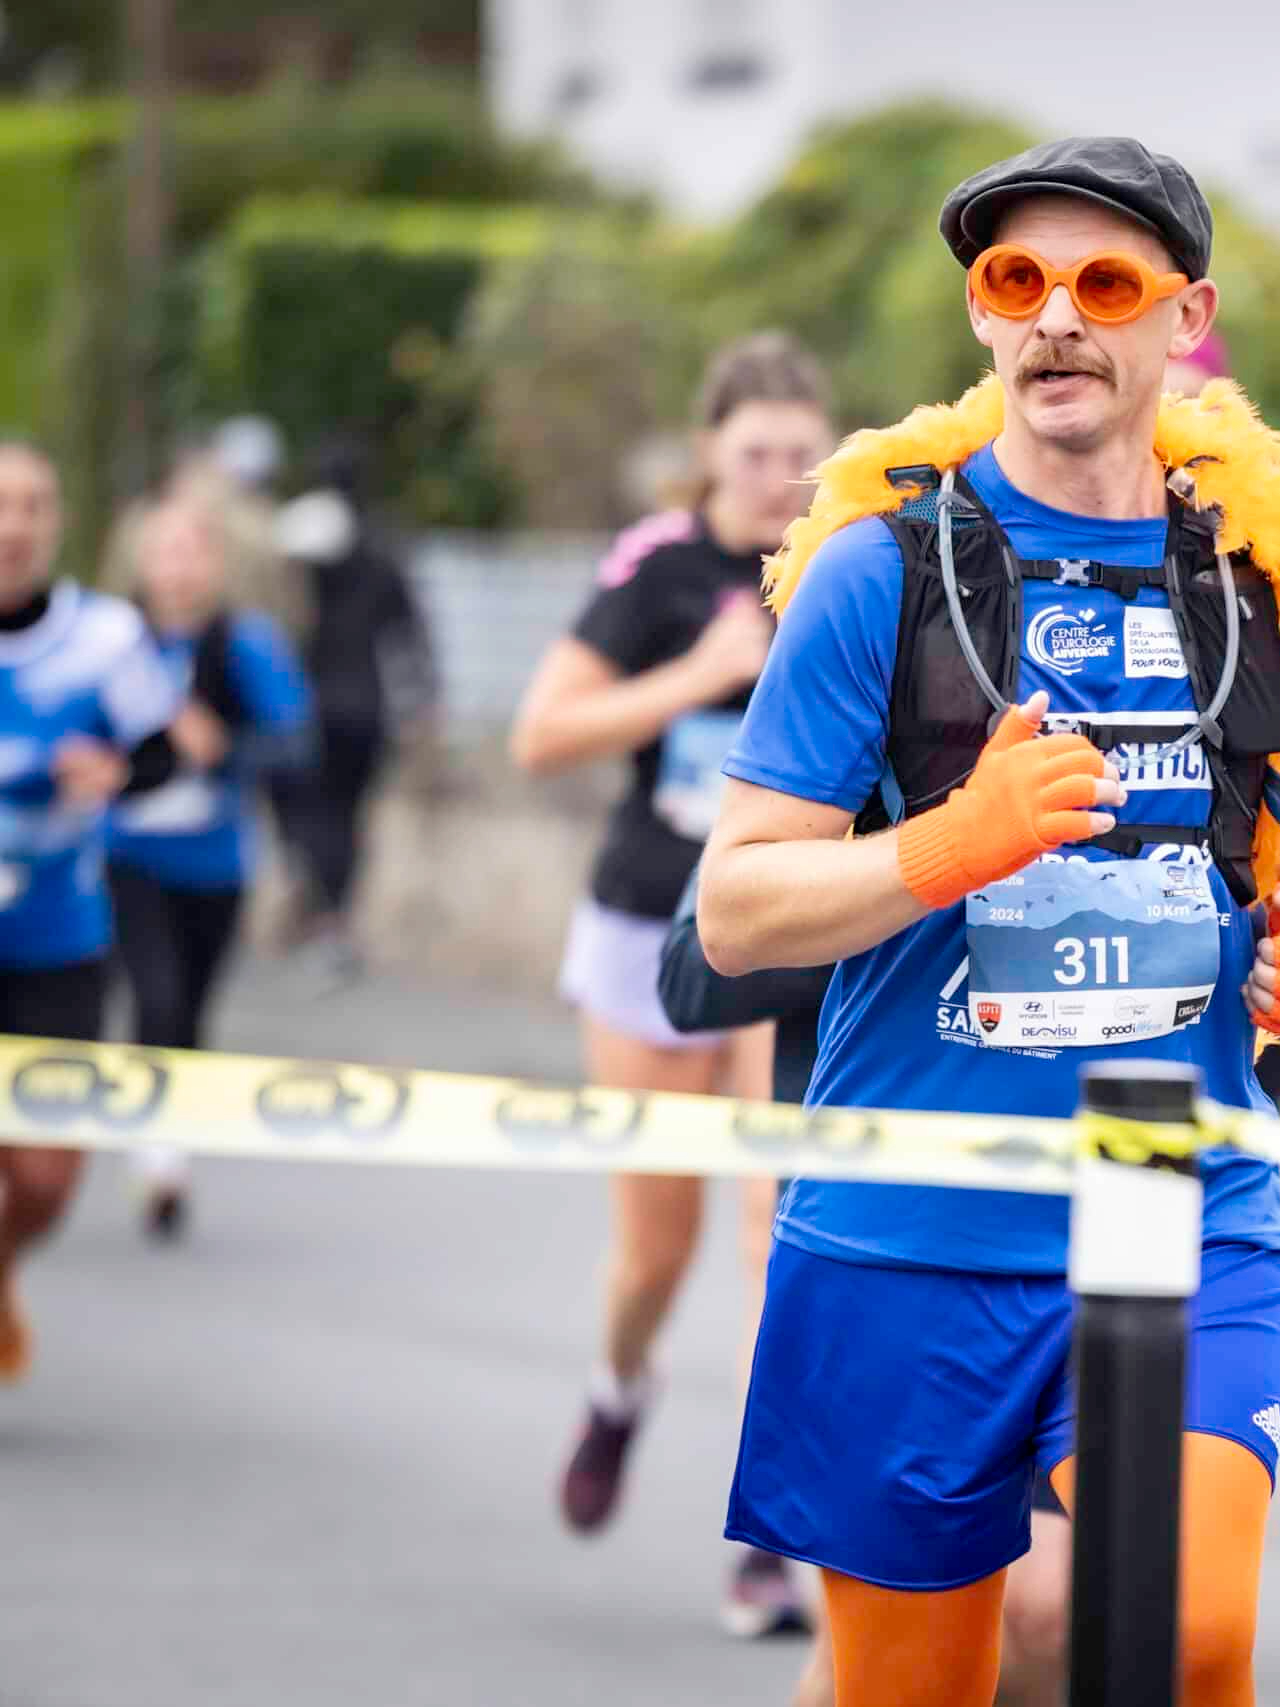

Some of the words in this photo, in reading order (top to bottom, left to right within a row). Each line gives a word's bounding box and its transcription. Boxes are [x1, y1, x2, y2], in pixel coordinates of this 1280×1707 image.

[1051, 626, 1090, 639] CENTRE
[1052, 635, 1117, 649] D'UROLOGIE
[1053, 646, 1110, 659] AUVERGNE
[1131, 658, 1157, 668] POUR
[1158, 657, 1181, 669] VOUS
[989, 907, 1024, 921] 2024
[1146, 904, 1161, 918] 10
[1053, 936, 1129, 985] 311
